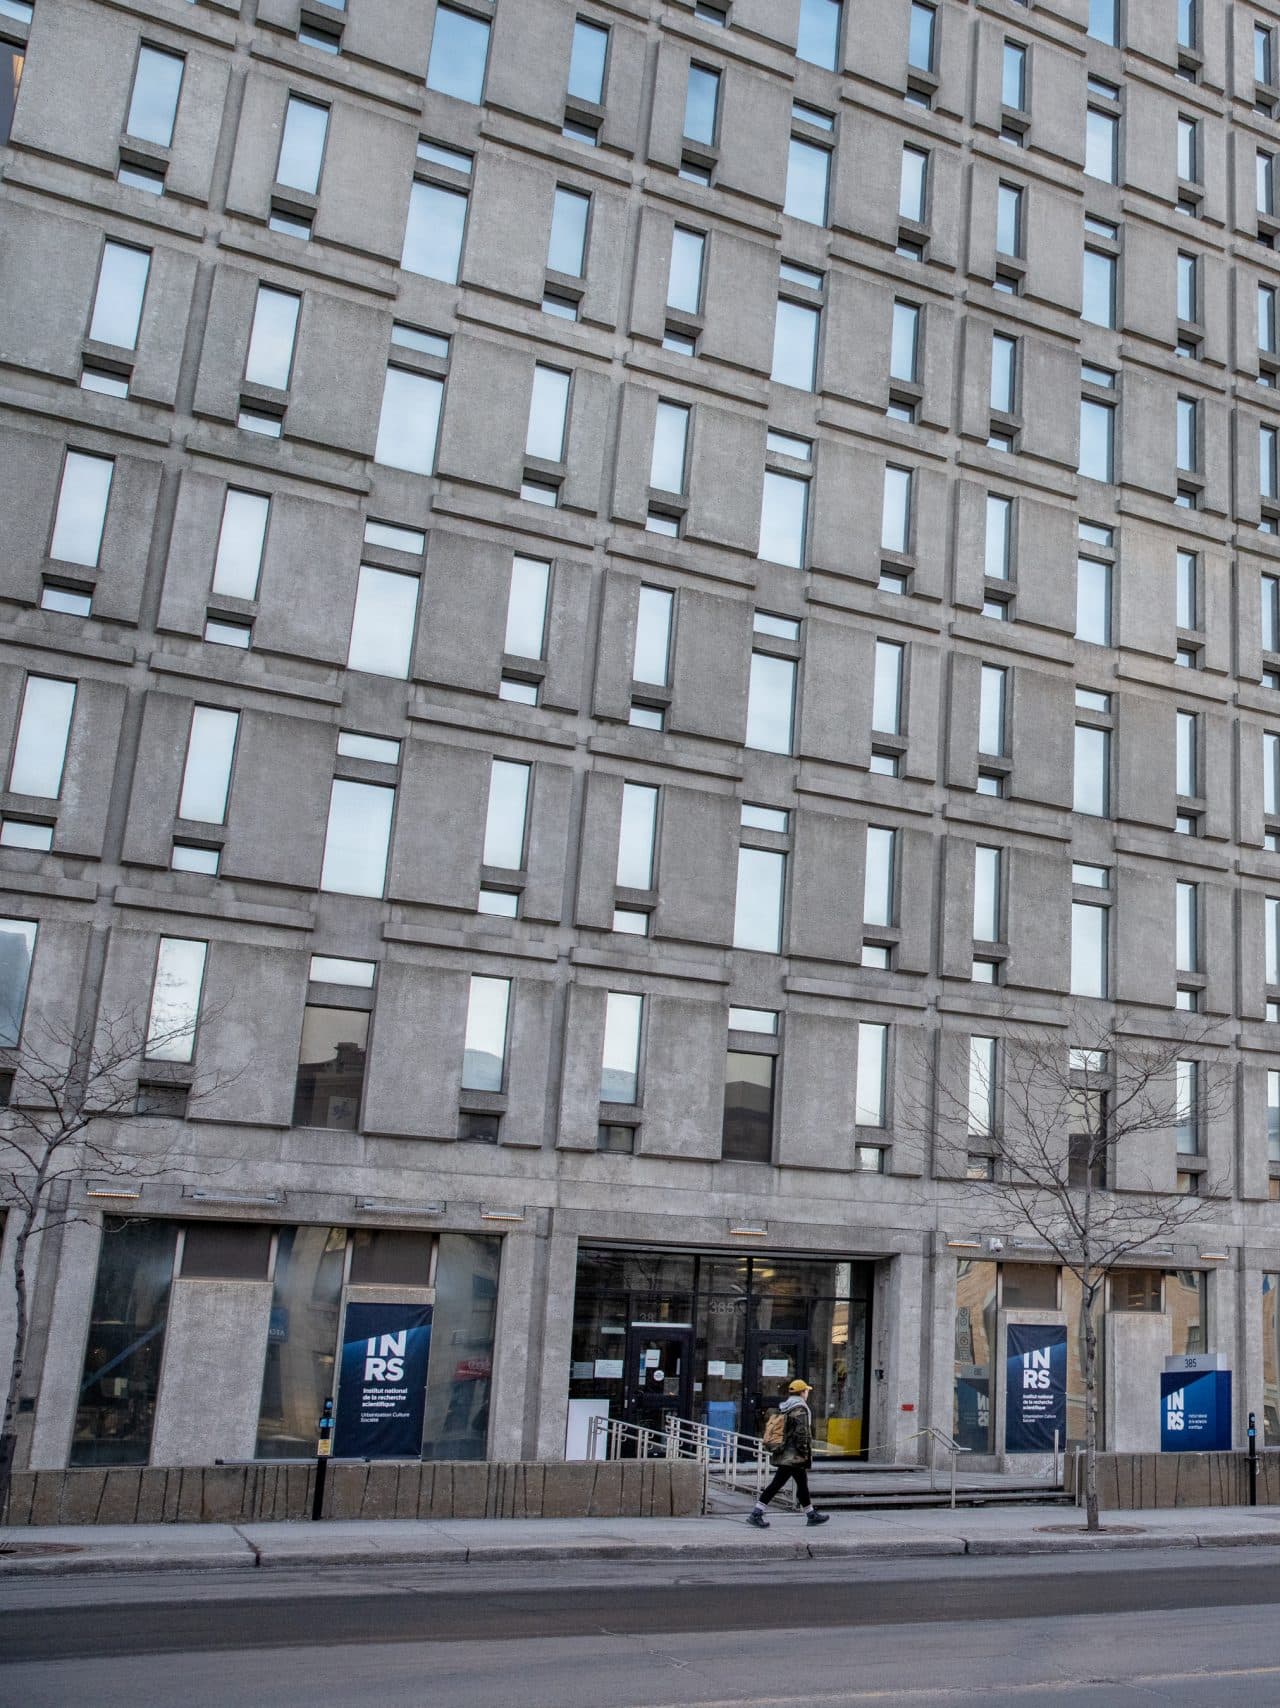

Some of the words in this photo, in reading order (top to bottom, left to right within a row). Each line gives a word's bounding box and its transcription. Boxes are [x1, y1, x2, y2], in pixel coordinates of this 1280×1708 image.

[709, 1301, 735, 1313] 385
[367, 1330, 407, 1356] IN
[1023, 1346, 1051, 1368] IN
[1184, 1358, 1197, 1368] 385
[364, 1357, 405, 1381] RS
[1023, 1369, 1051, 1389] RS
[1167, 1387, 1184, 1410] IN
[1167, 1411, 1184, 1430] RS
